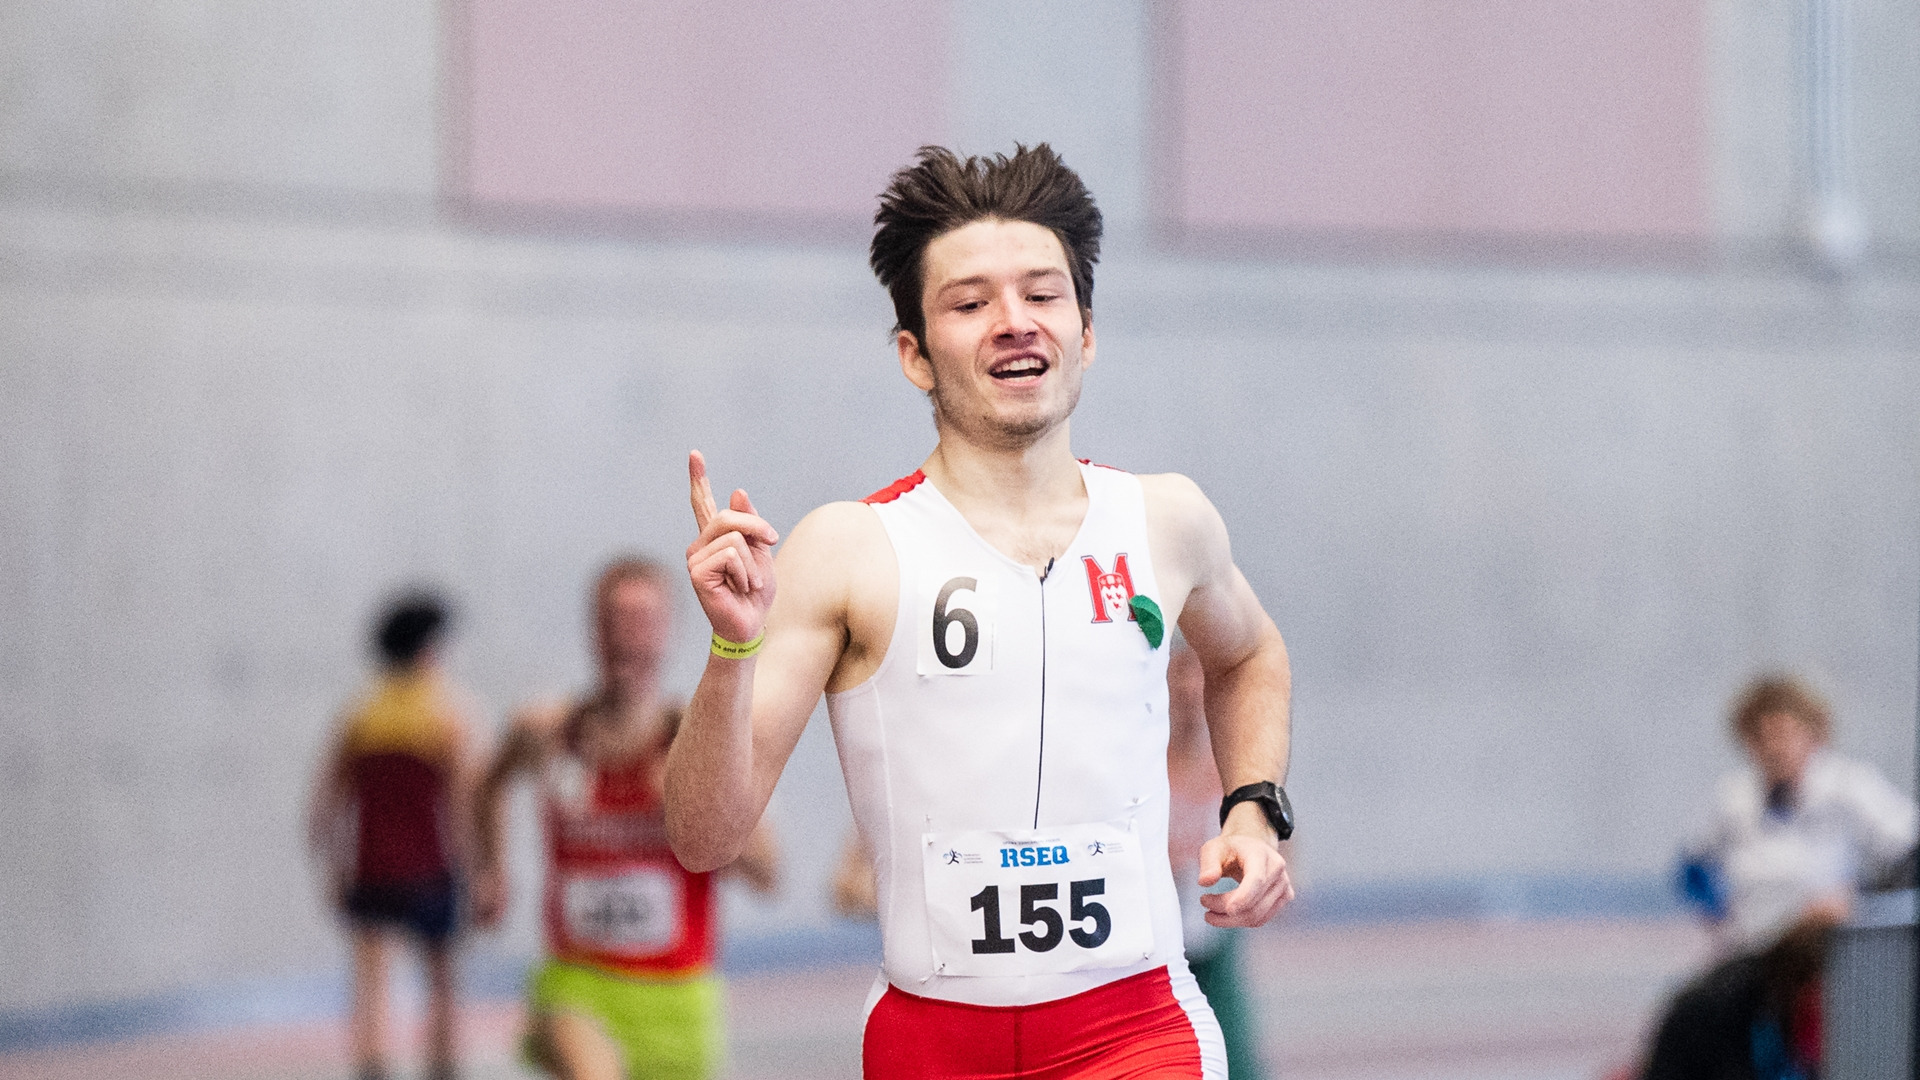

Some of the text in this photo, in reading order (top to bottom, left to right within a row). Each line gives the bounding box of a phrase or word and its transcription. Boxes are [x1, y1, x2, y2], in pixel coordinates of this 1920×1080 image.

[933, 576, 979, 669] 6
[1000, 845, 1070, 868] RSEQ
[970, 878, 1112, 955] 155
